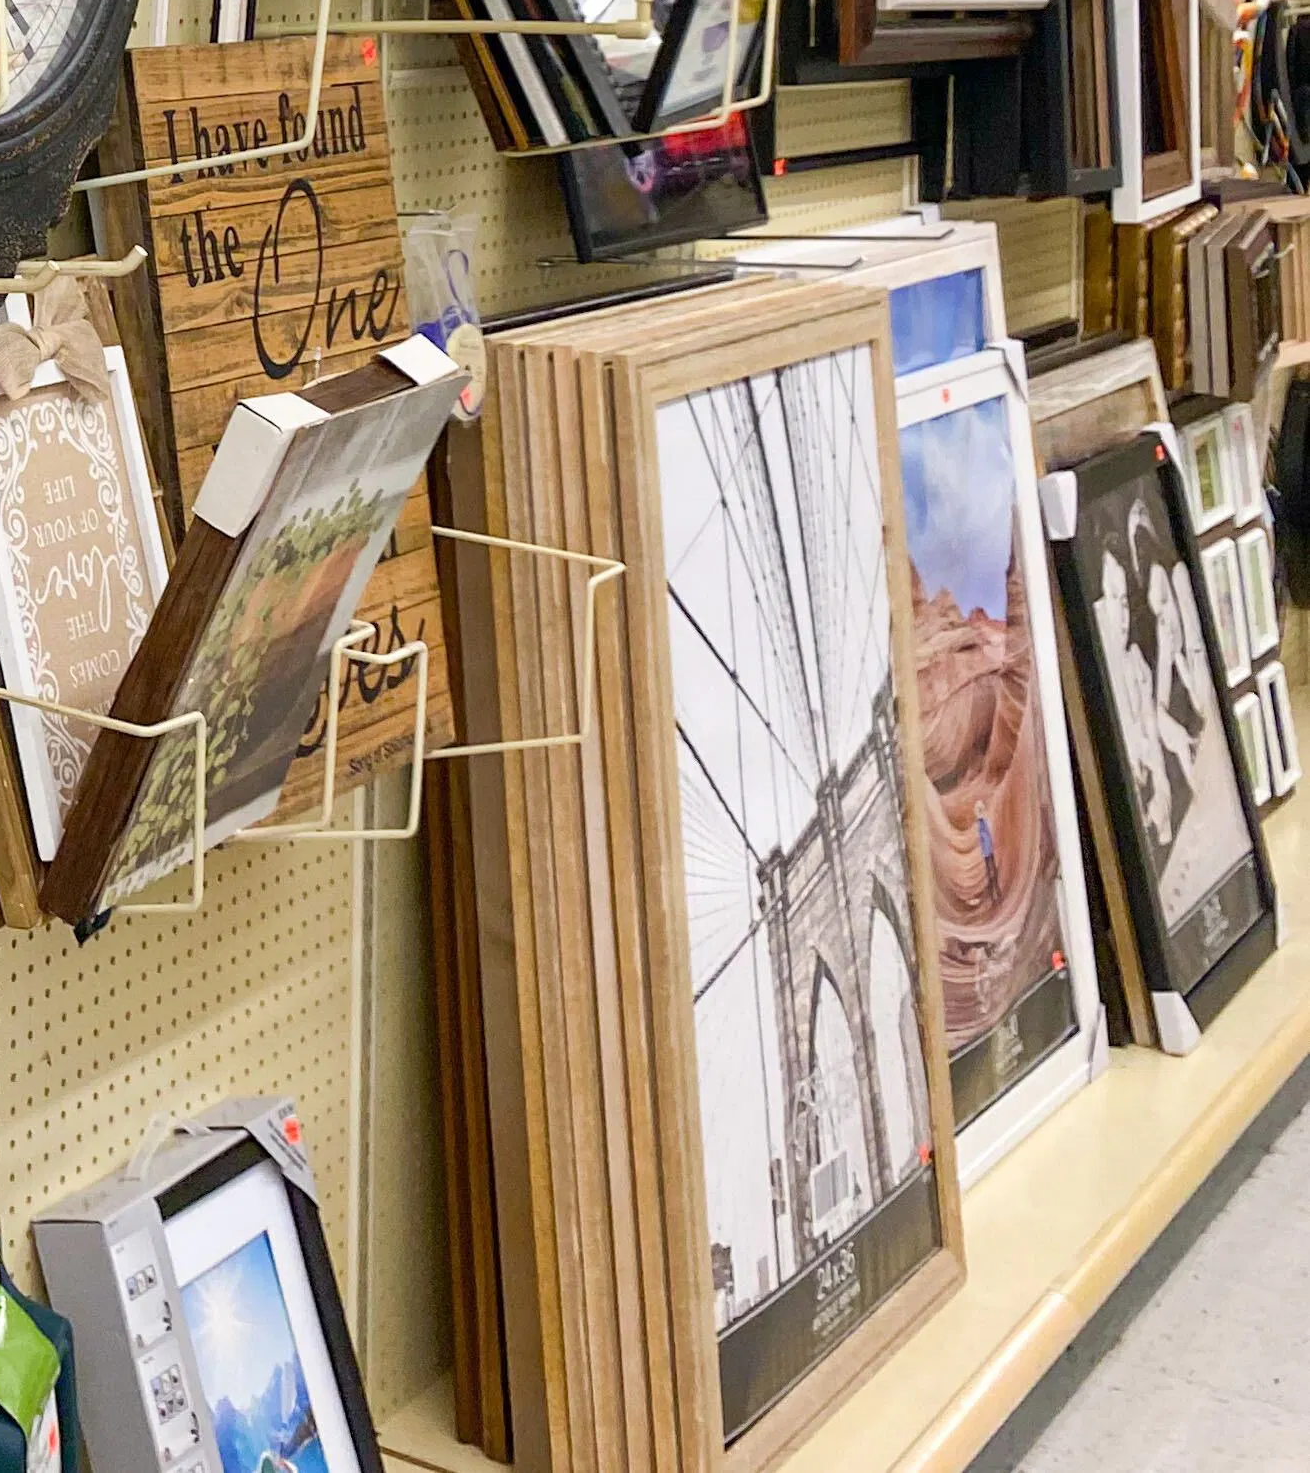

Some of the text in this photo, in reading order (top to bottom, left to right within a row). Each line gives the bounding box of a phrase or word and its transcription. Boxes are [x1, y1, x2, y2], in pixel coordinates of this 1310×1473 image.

[189, 106, 268, 179] have
[278, 85, 367, 164] found
[181, 178, 402, 381] the One
[42, 475, 77, 505] LIFE
[32, 514, 78, 550] YOUR
[66, 609, 102, 642] THE
[70, 648, 121, 690] COMES
